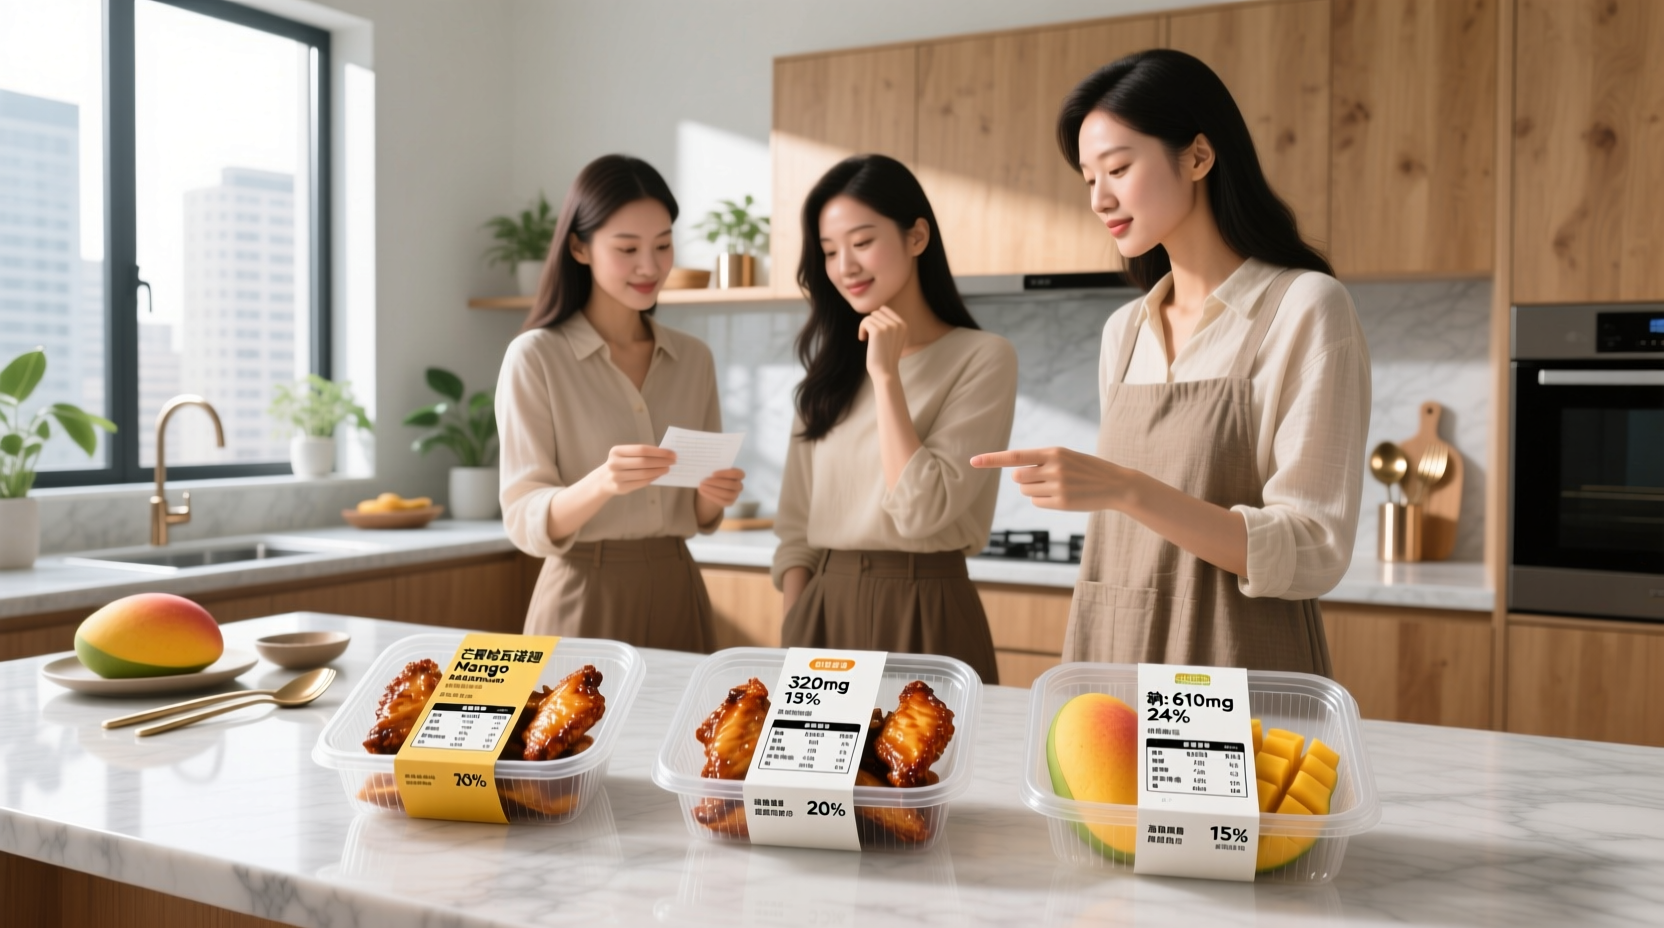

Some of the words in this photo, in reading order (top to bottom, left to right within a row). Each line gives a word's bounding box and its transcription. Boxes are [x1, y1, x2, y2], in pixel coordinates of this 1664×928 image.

[454, 661, 509, 677] Mango
[788, 676, 850, 694] 320mg
[1172, 692, 1234, 712] 610mg
[1147, 708, 1190, 723] 24%
[807, 801, 846, 816] 20%
[1210, 826, 1249, 843] 15%
